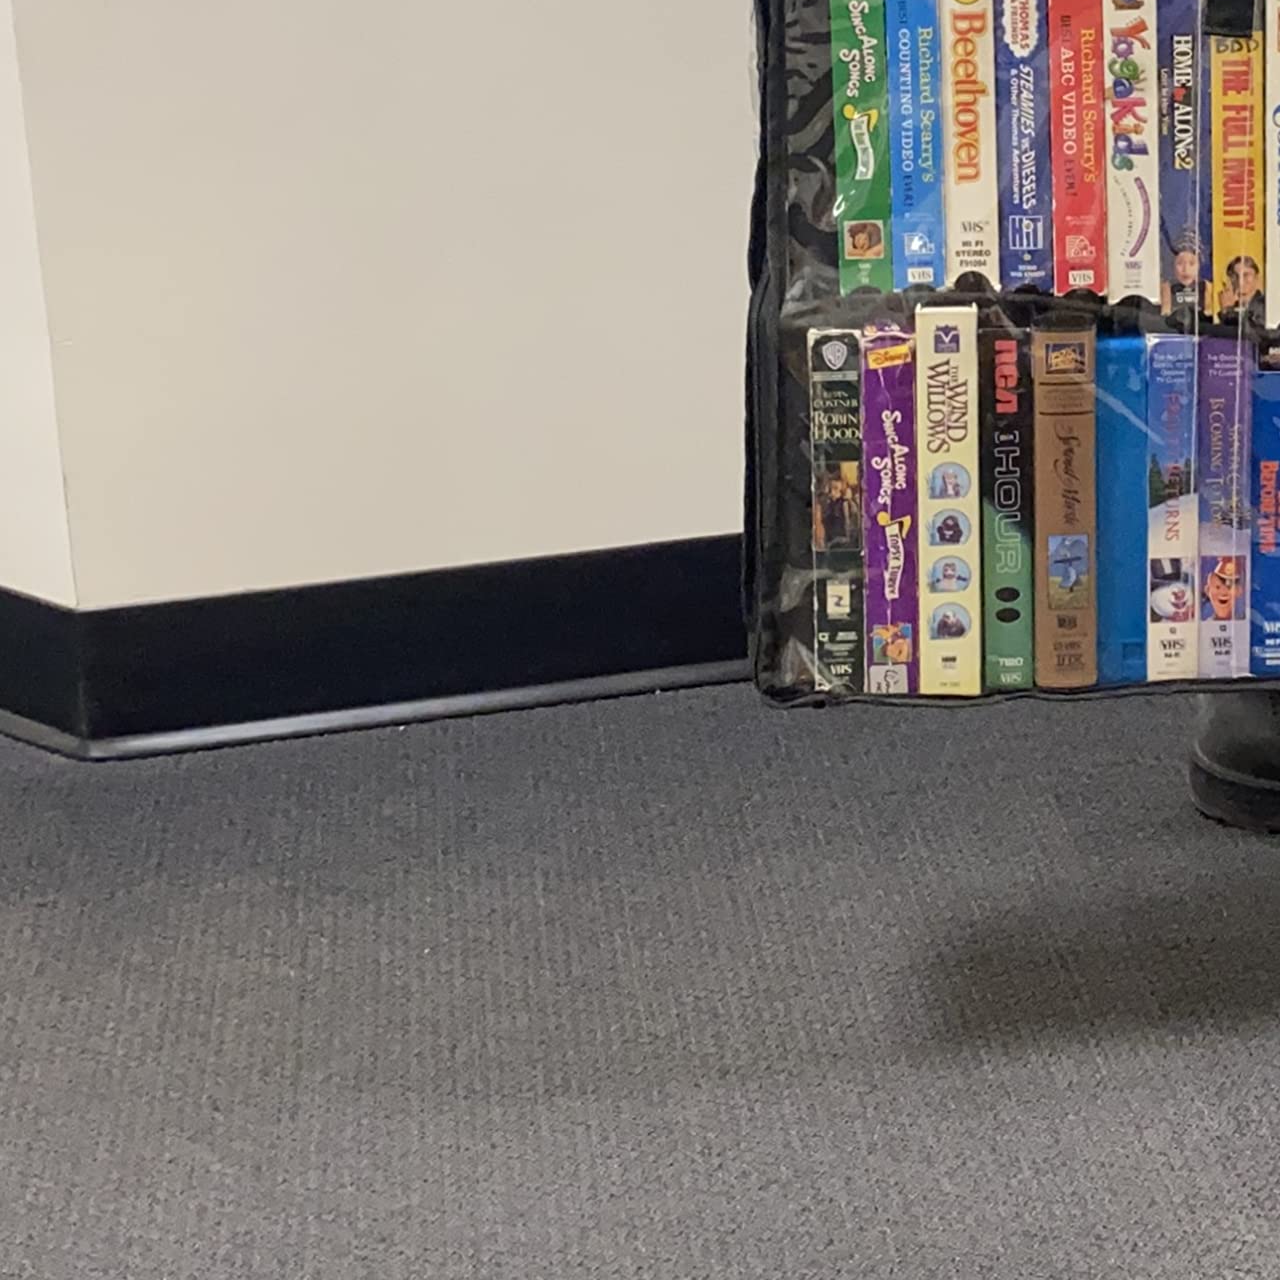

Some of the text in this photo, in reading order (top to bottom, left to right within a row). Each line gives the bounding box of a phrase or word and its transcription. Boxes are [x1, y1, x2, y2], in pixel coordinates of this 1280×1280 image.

[899, 28, 913, 115] COUNTING
[1061, 48, 1075, 86] ABC
[1173, 35, 1193, 87] HOME
[918, 26, 935, 183] Richard Scarry's
[951, 9, 987, 184] Beethoven
[1010, 79, 1019, 106] Other
[1019, 63, 1035, 137] STEAMIES
[1081, 28, 1096, 183] Richard Scarry's
[901, 119, 914, 172] VIDEO
[1010, 109, 1019, 146] Thomas
[1062, 90, 1077, 154] VIDEO
[1222, 56, 1254, 232] THE FULL MONTY
[1011, 147, 1020, 204] Adventures
[1021, 150, 1037, 210] DIESELS
[955, 249, 991, 258] STEREO
[960, 221, 985, 233] VHS
[1070, 272, 1093, 284] VHS
[872, 350, 910, 365] Disney
[994, 340, 1019, 414] RCA
[814, 410, 860, 426] ROBIN
[926, 359, 951, 454] WILLOWS
[947, 378, 969, 443] WIND
[1209, 409, 1225, 472] COMING
[994, 446, 1022, 574] HOUR
[1165, 463, 1182, 542] RETURNS
[1258, 460, 1279, 513] BEFORE
[830, 664, 853, 676] VHS
[1160, 640, 1185, 651] VHS
